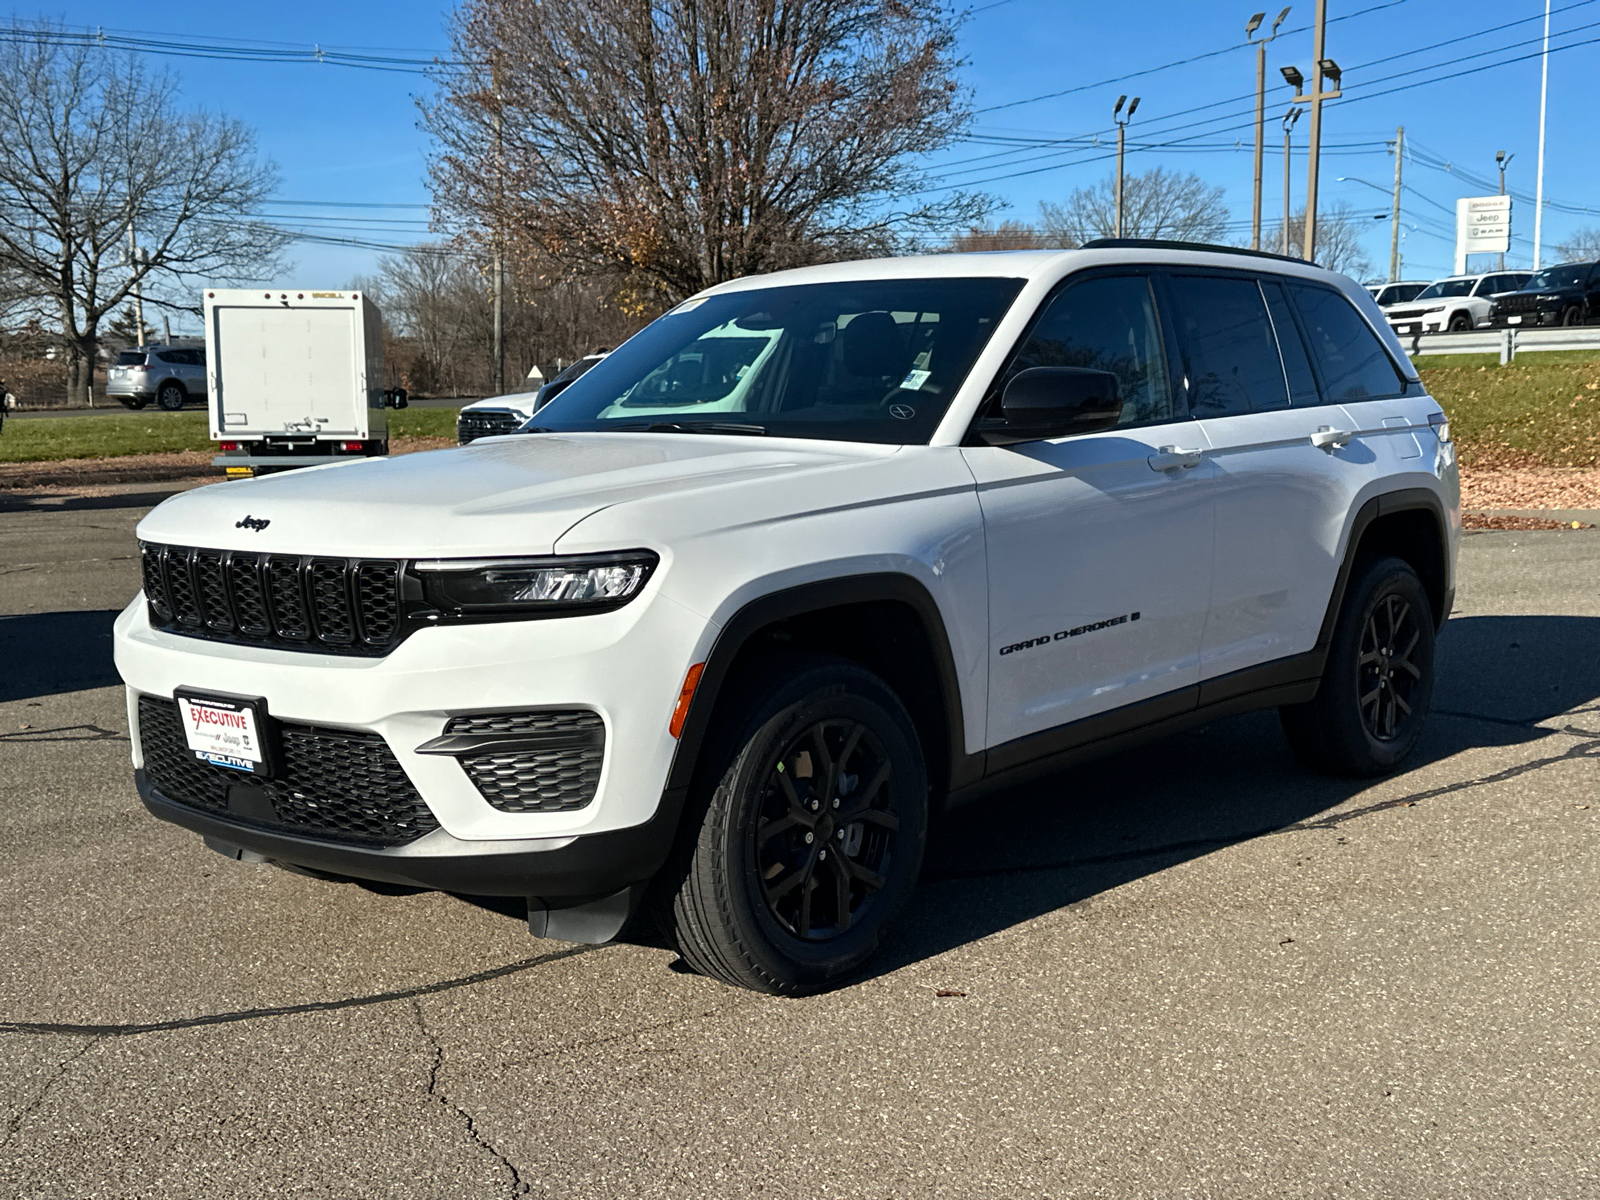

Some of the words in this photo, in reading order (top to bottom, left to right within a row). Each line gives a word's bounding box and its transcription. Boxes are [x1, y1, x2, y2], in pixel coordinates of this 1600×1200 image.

[1476, 213, 1500, 222] Jeep
[235, 514, 271, 533] Jeep
[999, 635, 1051, 656] GRAND
[1053, 614, 1128, 641] CHEROKEE
[190, 706, 247, 730] EXECUTIVE
[195, 751, 254, 770] EXECUTIVE
